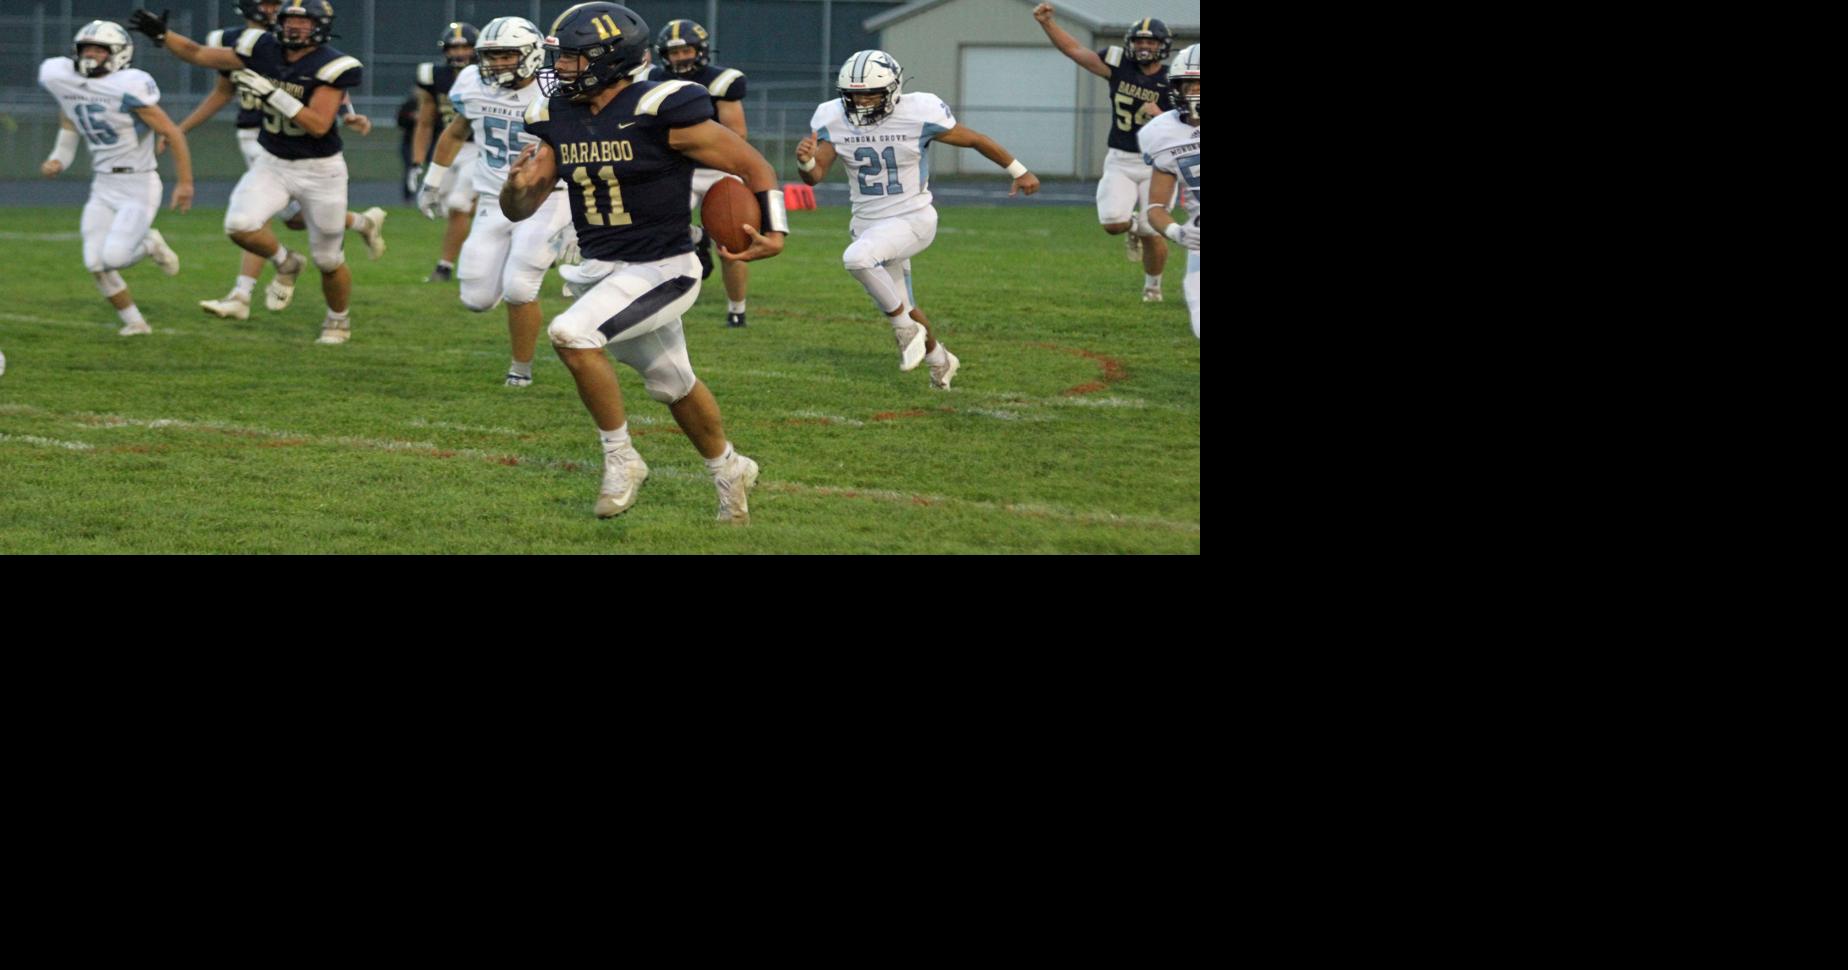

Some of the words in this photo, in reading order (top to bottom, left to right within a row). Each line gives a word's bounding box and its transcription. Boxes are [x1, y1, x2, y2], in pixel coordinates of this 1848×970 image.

[592, 14, 621, 40] 11
[1118, 81, 1159, 102] BARABOO
[481, 106, 512, 116] MONONA
[74, 103, 118, 145] 15
[880, 134, 906, 142] GROVE
[1170, 142, 1200, 156] MONON
[560, 140, 634, 164] BARABOO
[854, 146, 904, 196] 21
[572, 165, 632, 226] 11
